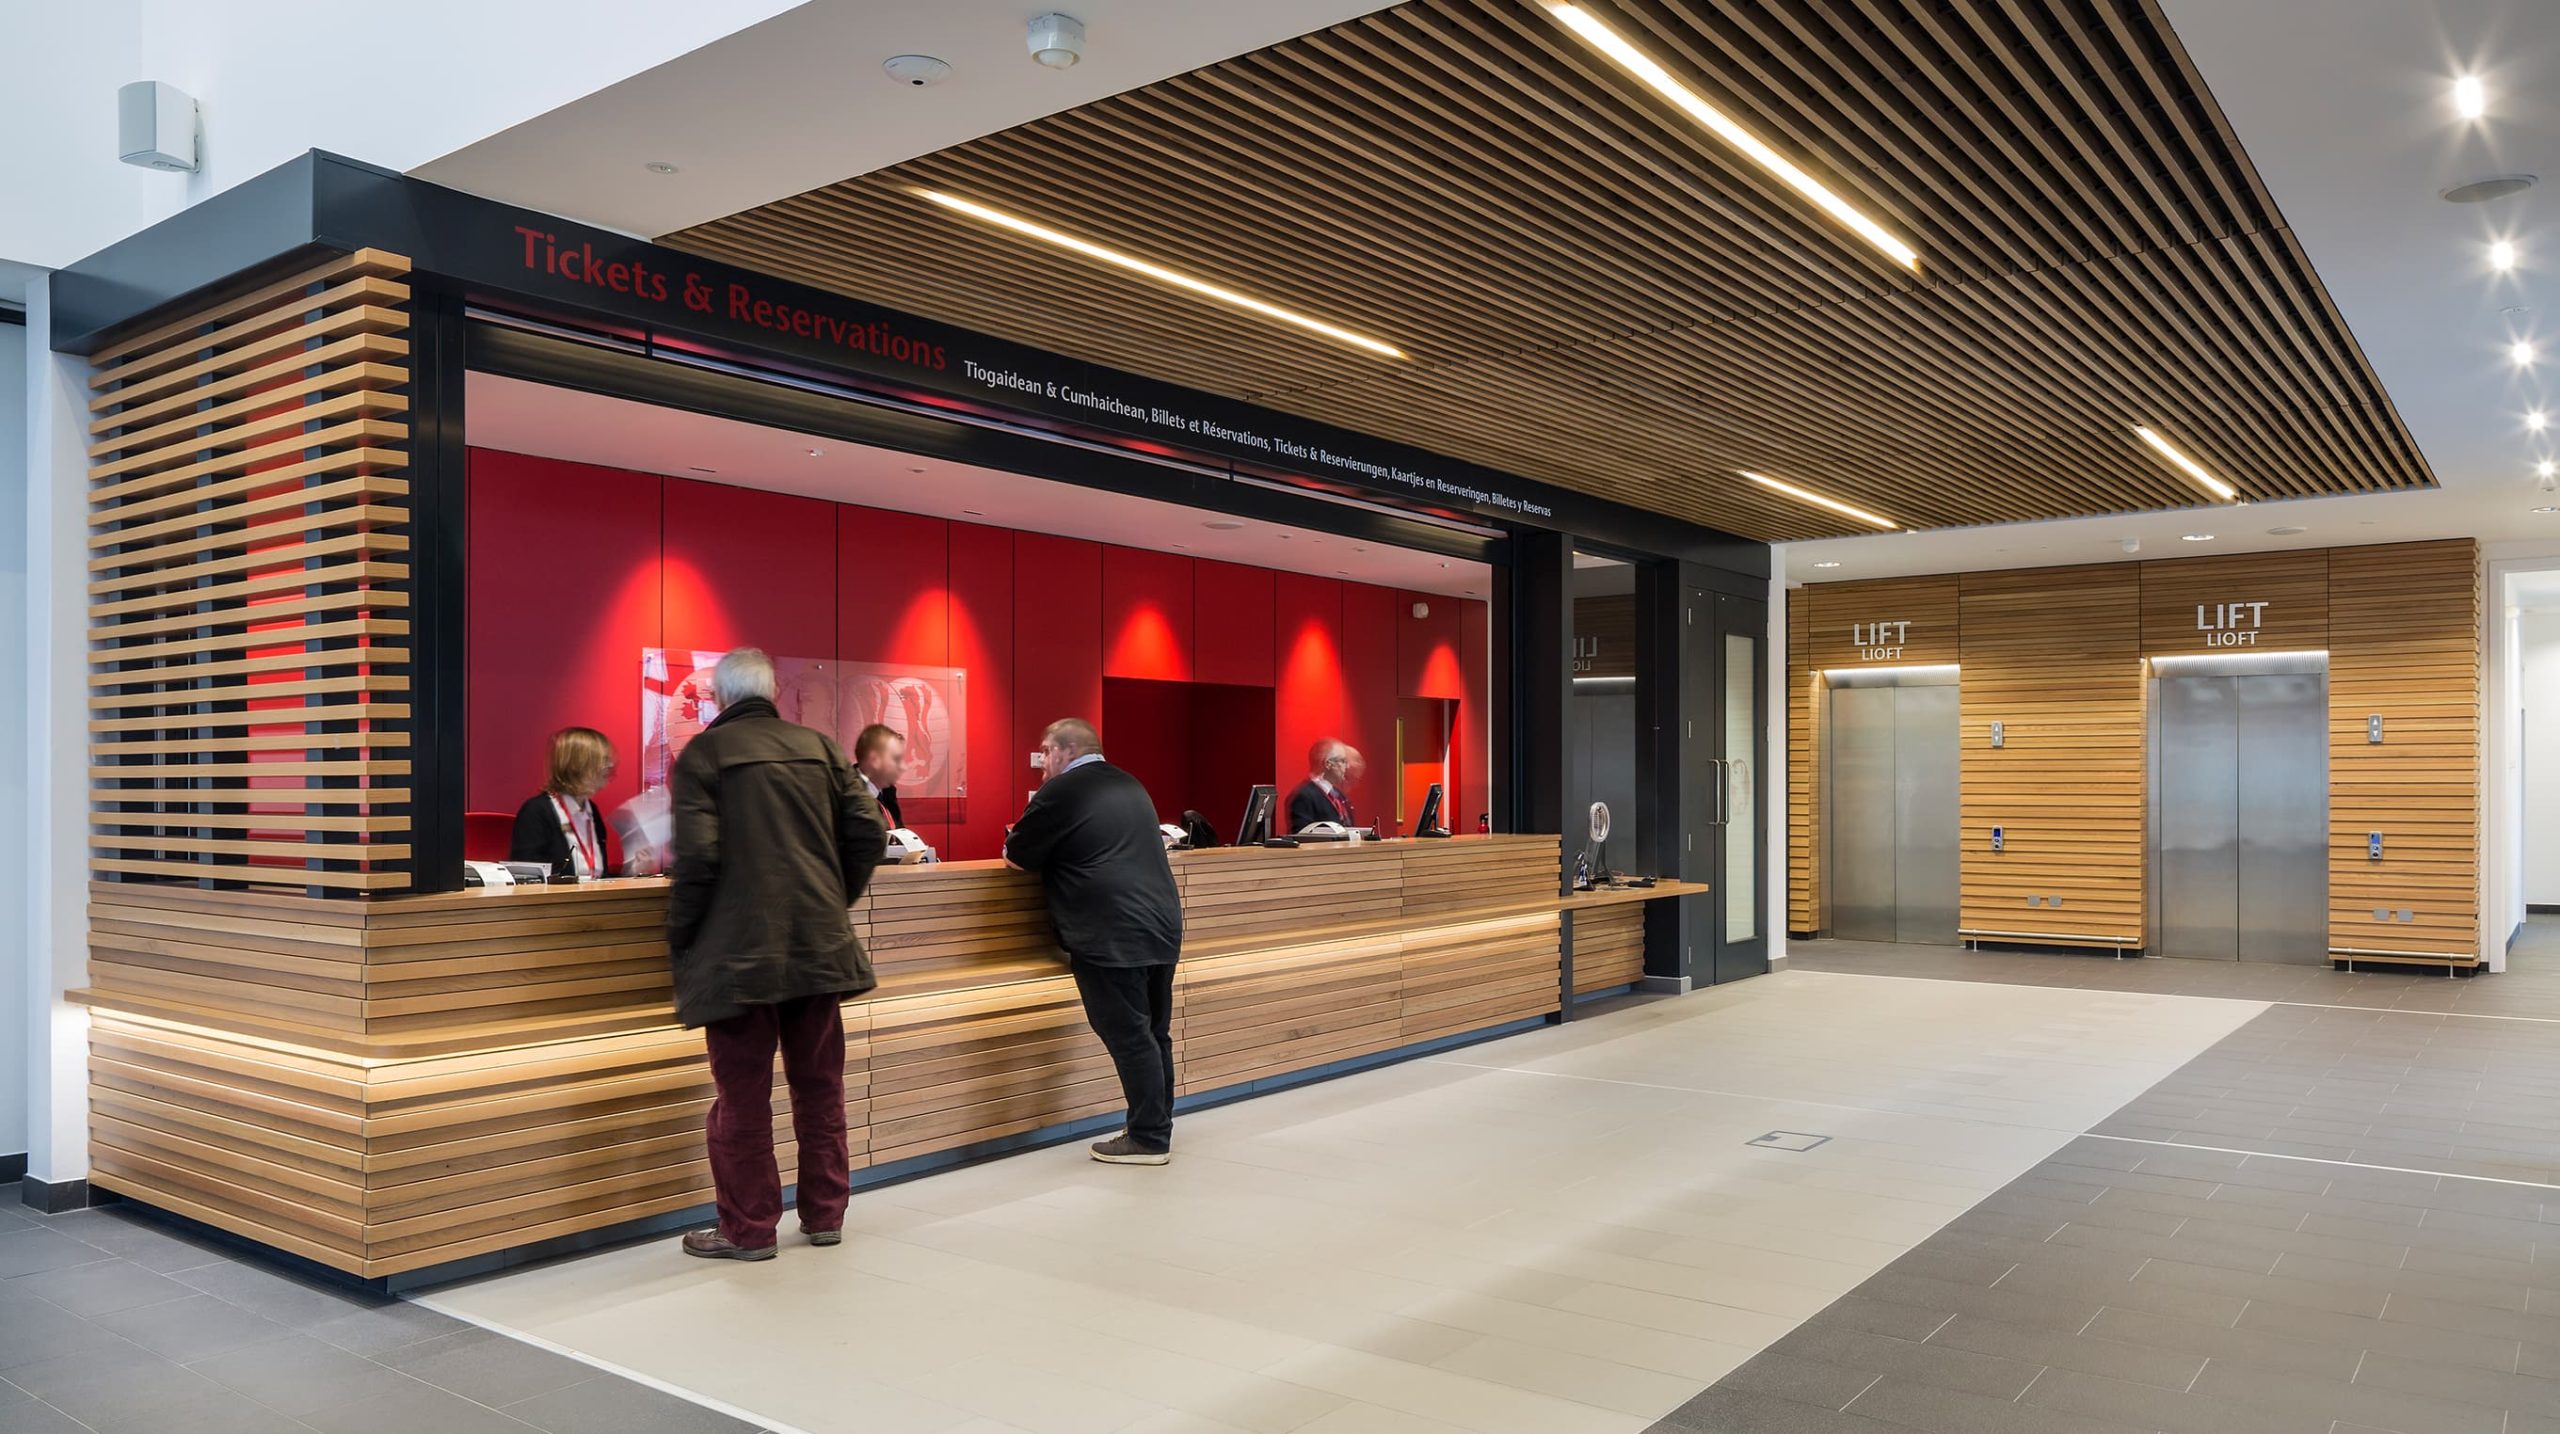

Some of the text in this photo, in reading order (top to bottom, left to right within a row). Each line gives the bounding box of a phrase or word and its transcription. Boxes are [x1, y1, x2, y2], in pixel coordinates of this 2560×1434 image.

[514, 226, 947, 372] Tickets & Reservations
[964, 360, 1552, 517] Tiogaidean & Cumhaichean, Billets et Réservations, Tickets & Reservierungen, Kaartjes en Reserveringen, Billetes y Reservas
[2197, 601, 2269, 630] LIFT
[1854, 621, 1911, 646] LIFT
[2207, 631, 2259, 646] LIOFT
[1862, 647, 1903, 660] LIOFT
